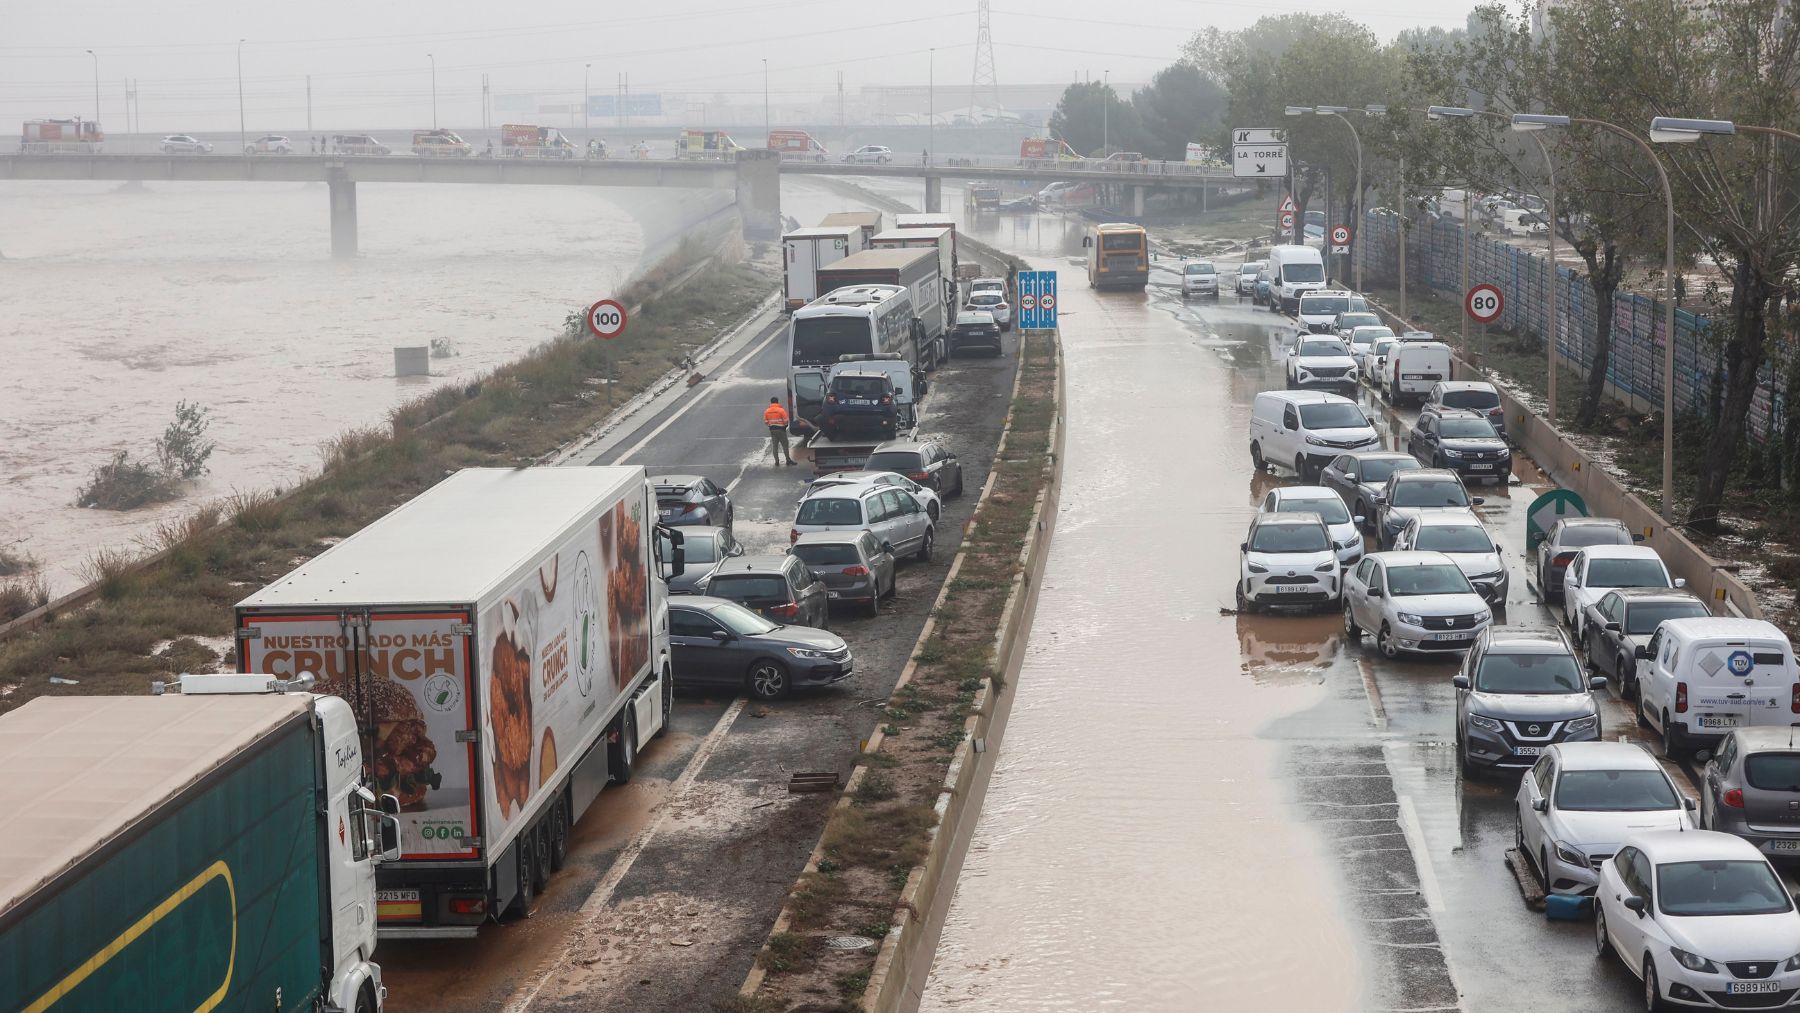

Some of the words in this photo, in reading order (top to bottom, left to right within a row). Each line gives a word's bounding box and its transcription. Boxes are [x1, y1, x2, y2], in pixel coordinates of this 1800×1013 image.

[1237, 151, 1249, 159] LA
[1253, 151, 1283, 159] TORRE
[1474, 297, 1496, 310] 80
[595, 313, 620, 326] 100
[263, 635, 350, 649] NUESTRO
[412, 630, 453, 647] MÁS
[262, 648, 455, 682] CRUNCH
[542, 640, 568, 688] CRUNCH
[1733, 983, 1758, 993] 6989
[1760, 981, 1778, 992] HKD
